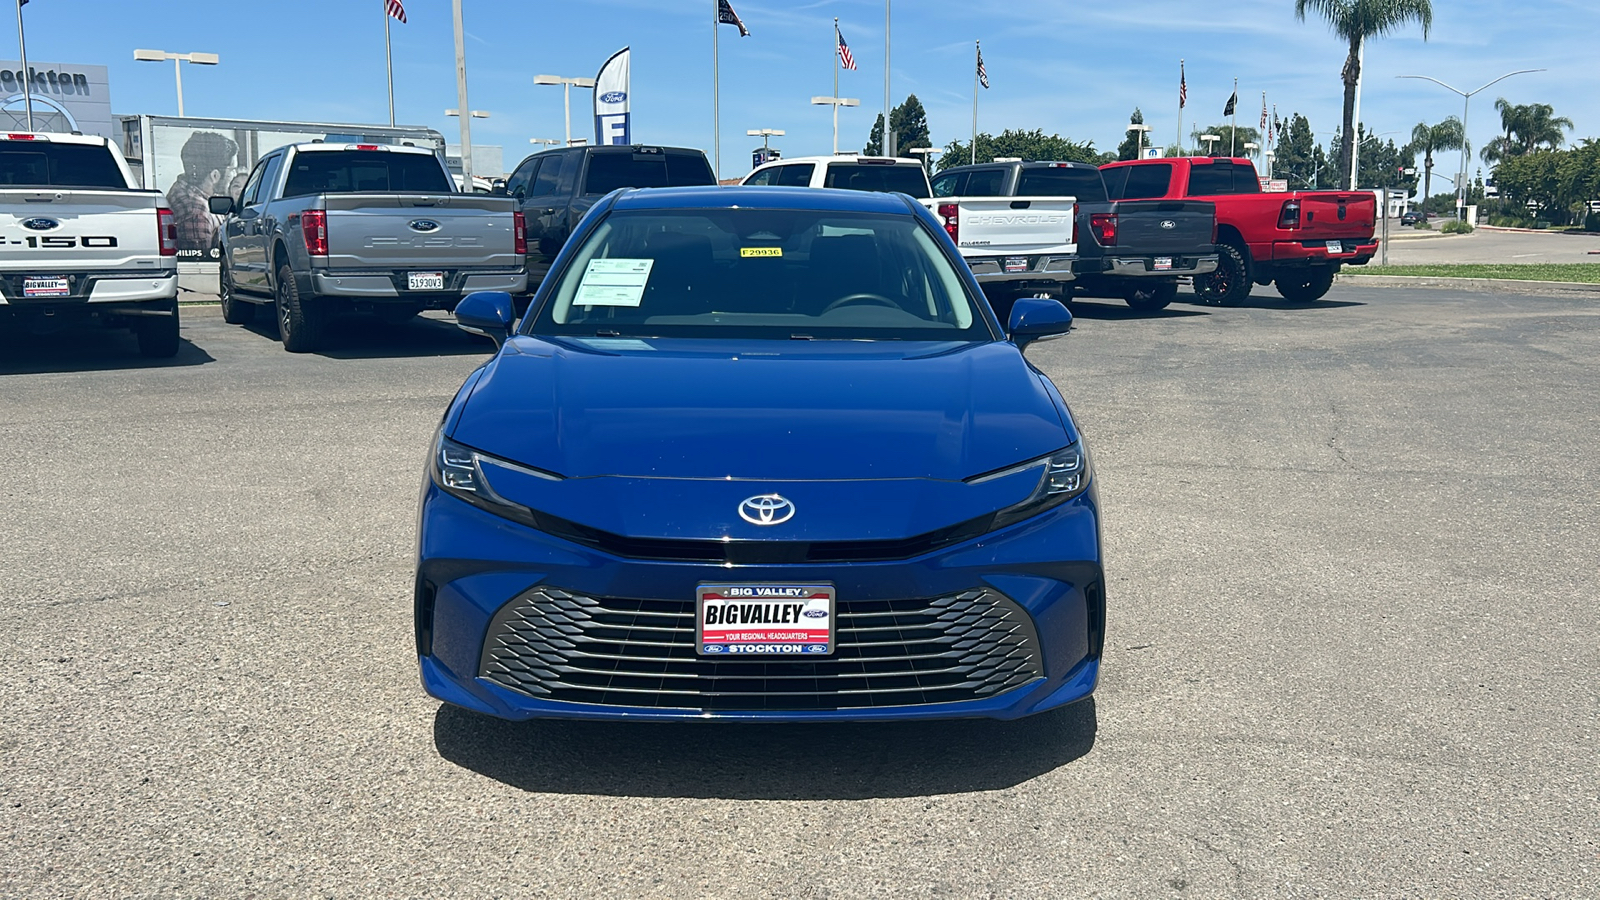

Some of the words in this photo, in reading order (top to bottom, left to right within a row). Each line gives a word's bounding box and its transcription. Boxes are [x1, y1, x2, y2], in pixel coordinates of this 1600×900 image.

[967, 215, 1067, 226] CHEVROLET
[0, 235, 118, 248] -150
[363, 235, 485, 248] F-150
[25, 280, 59, 289] BIGVALLEY
[410, 278, 442, 289] 51930V3
[730, 588, 753, 596] BIG
[755, 588, 802, 596] VALLEY
[705, 604, 804, 624] BIGVALLEY
[725, 633, 741, 641] YOUR
[740, 632, 767, 641] REGIONAL
[767, 632, 808, 640] HEADQUARTERS
[728, 644, 802, 653] STOCKTON
